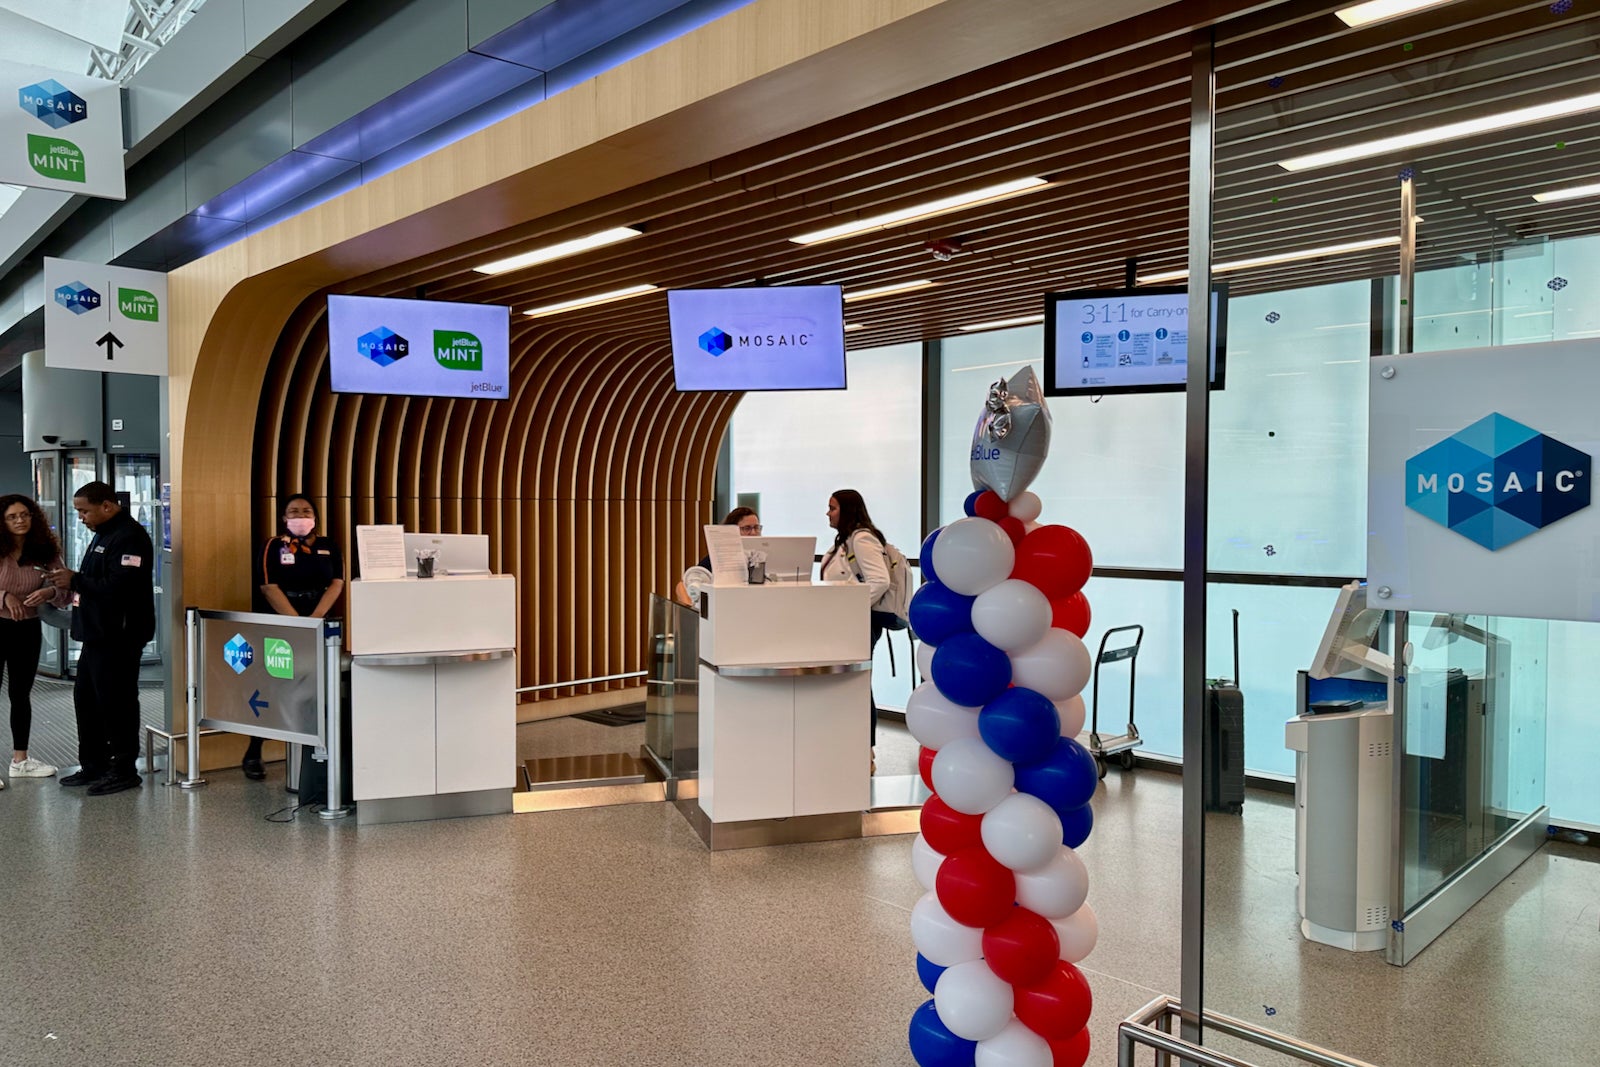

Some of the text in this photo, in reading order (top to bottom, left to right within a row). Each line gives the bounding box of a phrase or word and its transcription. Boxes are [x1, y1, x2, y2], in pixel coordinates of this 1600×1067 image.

[49, 144, 79, 157] jetBlue
[33, 152, 80, 172] MINT
[57, 292, 98, 304] MOSAIC
[121, 301, 155, 315] MINT
[1131, 308, 1144, 319] for
[361, 342, 405, 352] MOSAIC
[452, 337, 478, 347] jetBlue
[437, 347, 479, 362] MINT
[470, 382, 502, 393] jetBlue
[226, 650, 252, 659] MOSAIC
[267, 655, 291, 669] MINT
